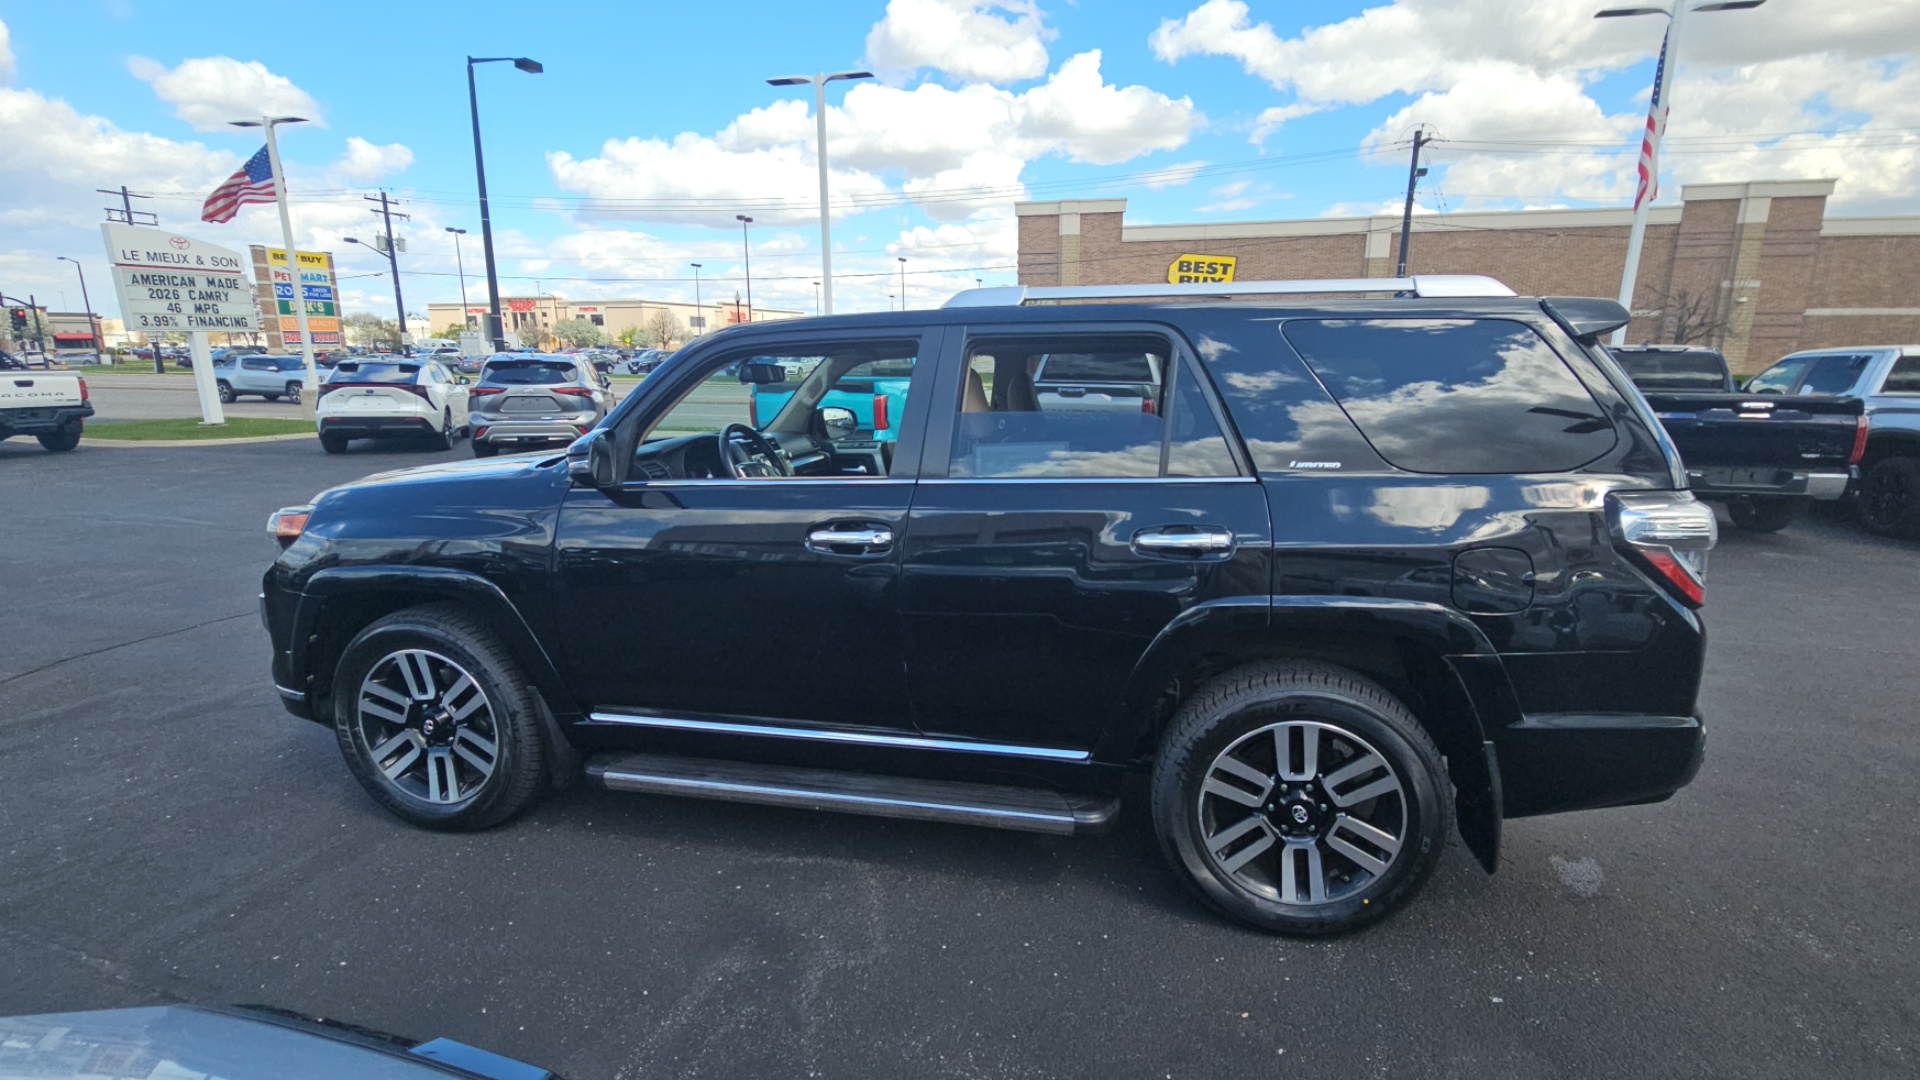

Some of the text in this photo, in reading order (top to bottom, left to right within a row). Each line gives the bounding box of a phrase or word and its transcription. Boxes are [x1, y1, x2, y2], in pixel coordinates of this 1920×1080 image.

[122, 250, 239, 268] LE MIEUX & SON
[300, 256, 322, 264] BUY
[1178, 260, 1232, 275] BEST
[131, 274, 240, 289] AMERICAN MADE
[274, 271, 328, 283] PETMART
[148, 288, 229, 302] 2026 CAMRY
[276, 285, 309, 297] ROS
[167, 302, 220, 314] 46 MPG
[288, 301, 325, 313] DK'S
[140, 315, 248, 327] 3.99% FINANCING
